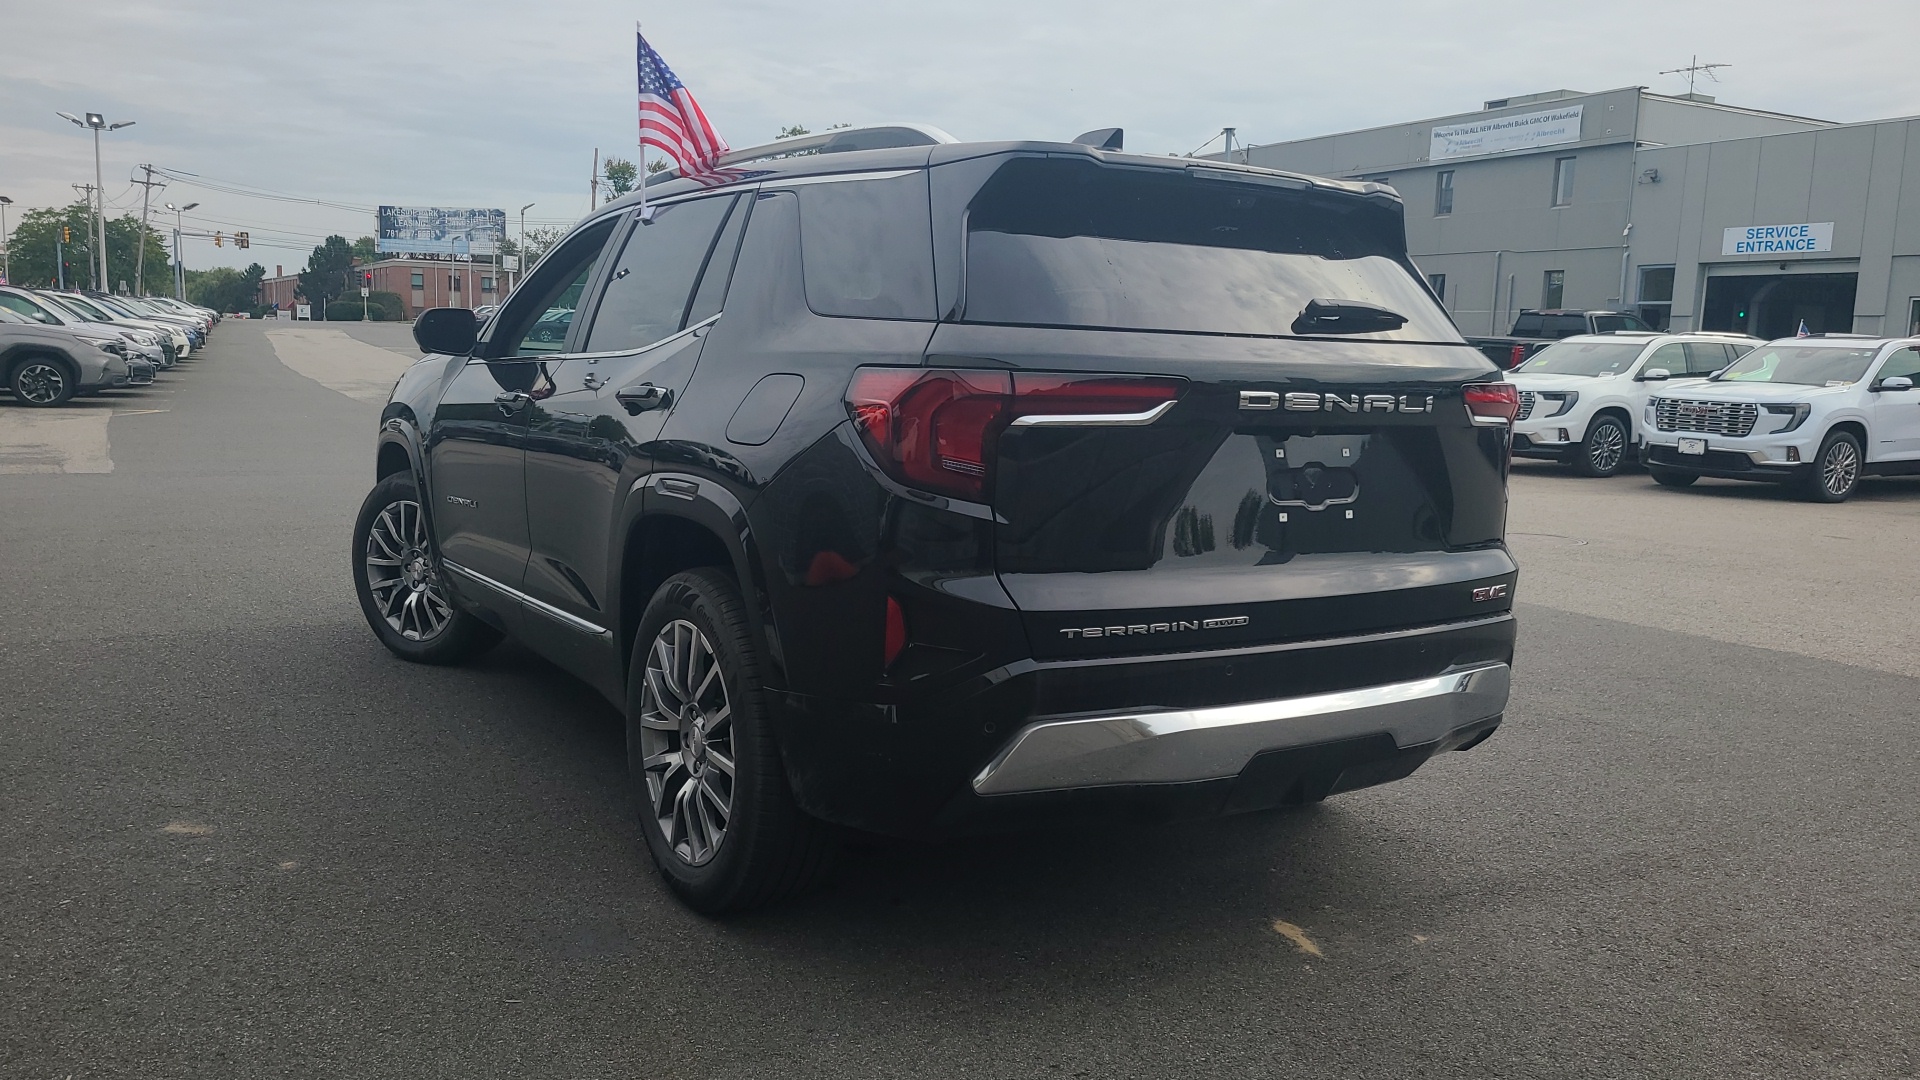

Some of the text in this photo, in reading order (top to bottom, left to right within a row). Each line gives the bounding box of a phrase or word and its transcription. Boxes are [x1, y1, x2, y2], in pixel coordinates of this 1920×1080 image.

[1434, 131, 1453, 139] Welcome
[1492, 121, 1514, 131] Albrecht
[1514, 119, 1529, 128] Buick
[1530, 116, 1542, 125] GMC
[1542, 115, 1551, 123] Of
[1551, 111, 1579, 121] Wakefield
[1536, 128, 1565, 138] Albrecht
[1746, 225, 1809, 240] SERVICE
[1736, 238, 1816, 253] ENTRANCE
[1238, 390, 1434, 413] DENALI
[446, 495, 478, 508] DENALI
[1472, 584, 1507, 602] GMC
[1059, 620, 1199, 639] TERRAIN
